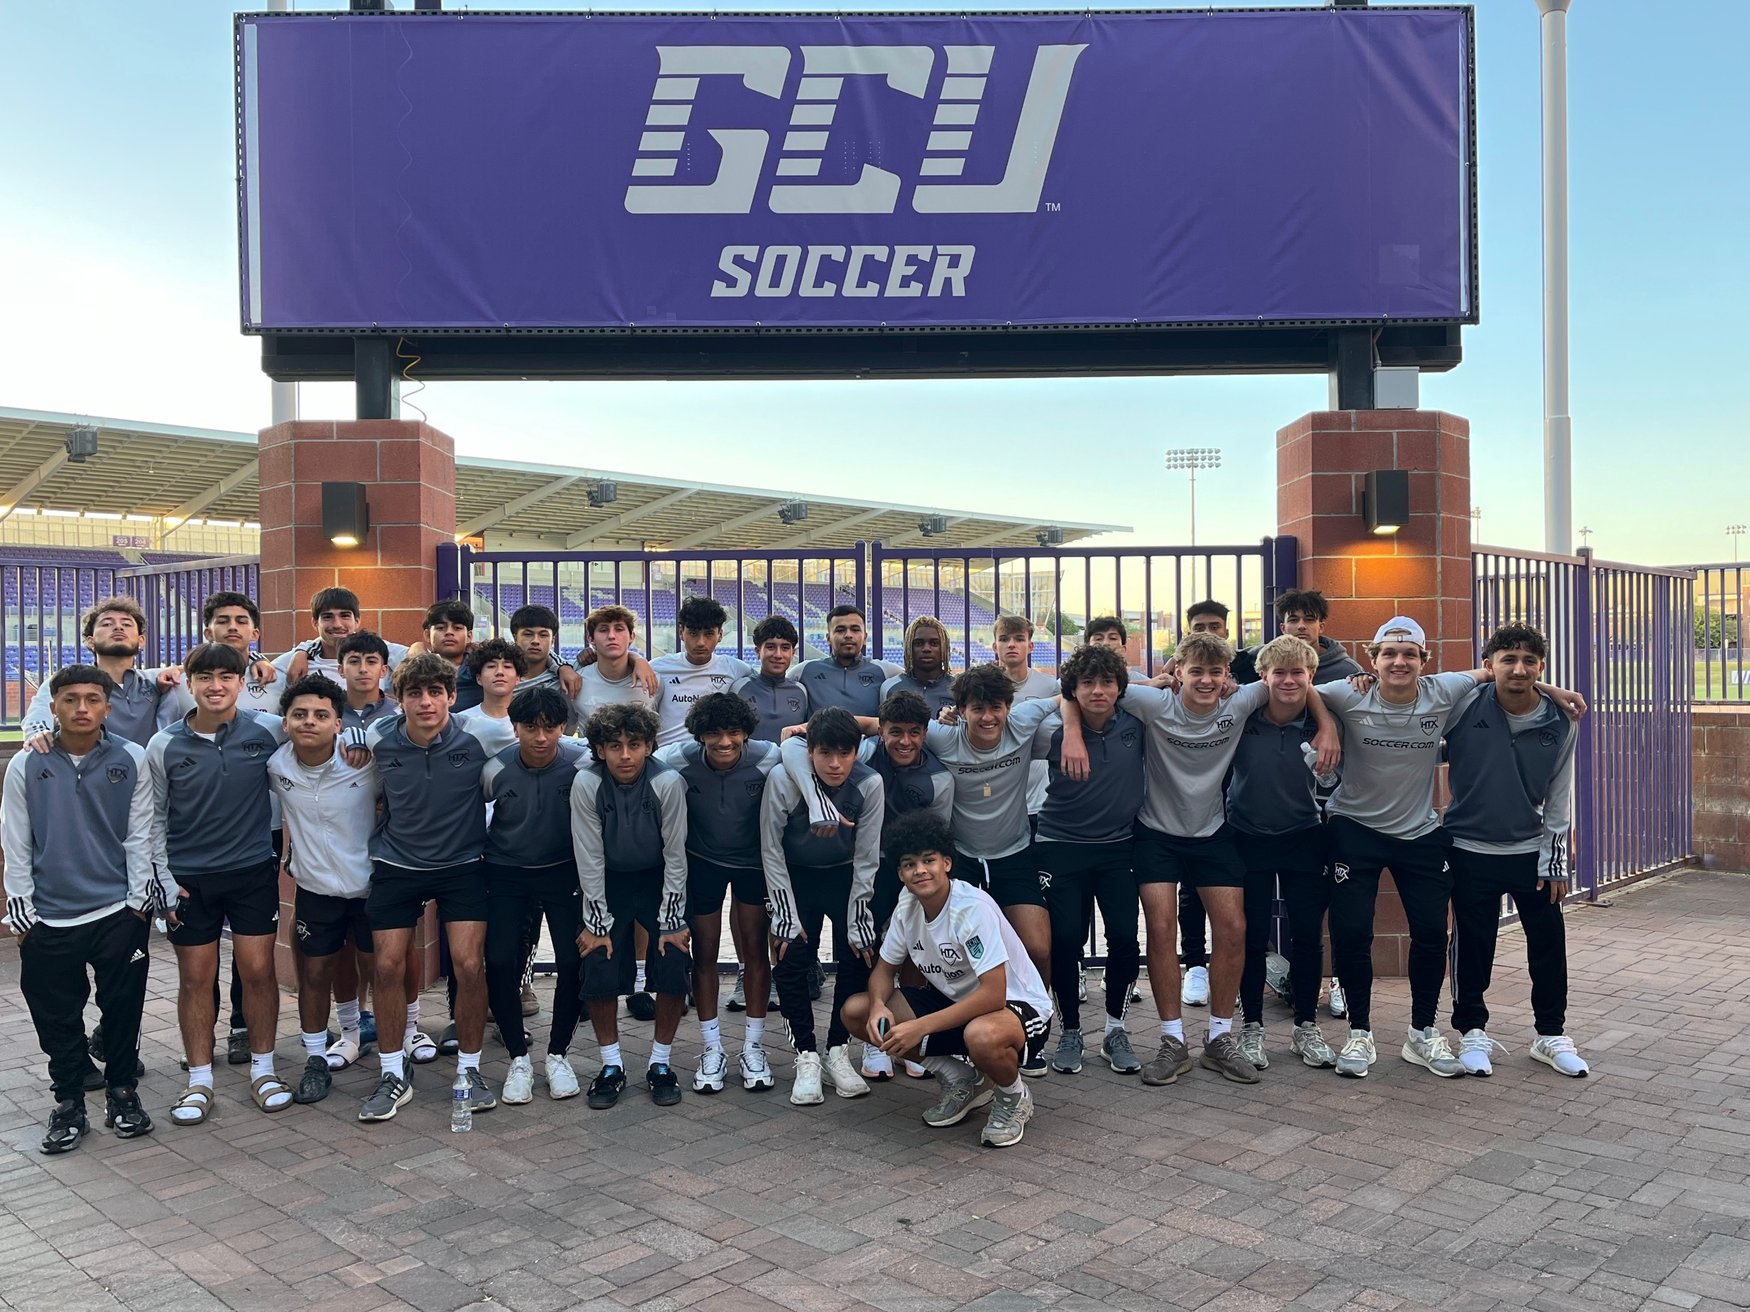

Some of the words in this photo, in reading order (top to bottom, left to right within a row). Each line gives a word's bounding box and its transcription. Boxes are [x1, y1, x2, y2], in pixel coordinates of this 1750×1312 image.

[624, 44, 1090, 213] GCU
[1045, 202, 1061, 212] TM
[710, 245, 976, 297] SOCCER
[711, 676, 727, 685] HTX
[860, 675, 874, 684] HTX
[247, 686, 268, 694] HTX
[671, 694, 701, 703] AutoN
[1217, 718, 1234, 730] HTX
[1420, 719, 1439, 729] HTX
[242, 743, 265, 752] HTX
[448, 752, 471, 762] HTX
[105, 767, 128, 780] HTX
[940, 948, 961, 960] HTX
